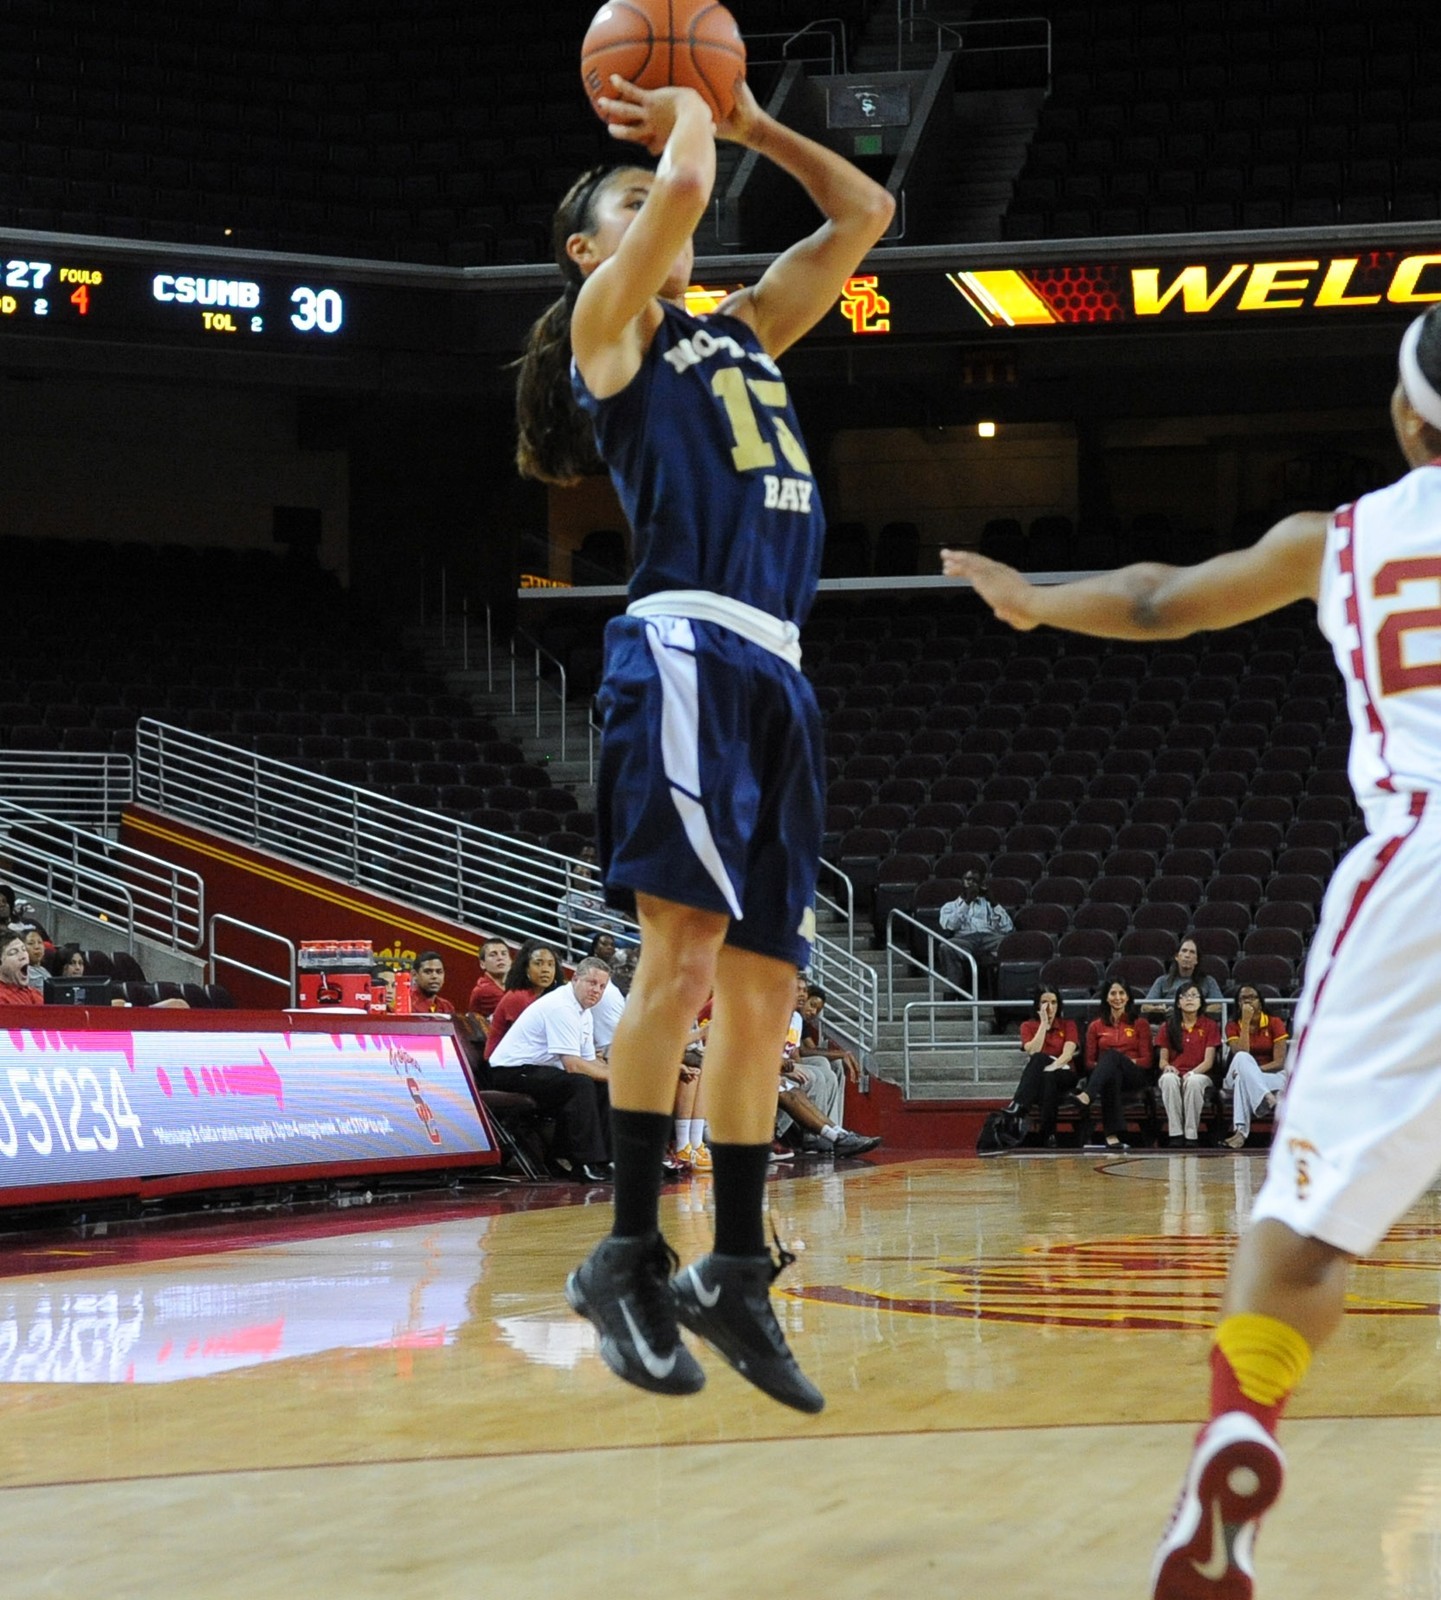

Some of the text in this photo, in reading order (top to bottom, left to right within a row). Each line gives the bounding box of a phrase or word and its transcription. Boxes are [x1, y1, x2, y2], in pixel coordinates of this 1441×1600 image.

[59, 267, 103, 285] FOULS
[153, 274, 260, 309] CSUMB
[1131, 254, 1441, 315] WELC
[33, 298, 49, 315] 2
[70, 284, 88, 315] 4
[290, 286, 343, 333] 30
[201, 312, 263, 333] TOL 2
[763, 474, 813, 514] BAY
